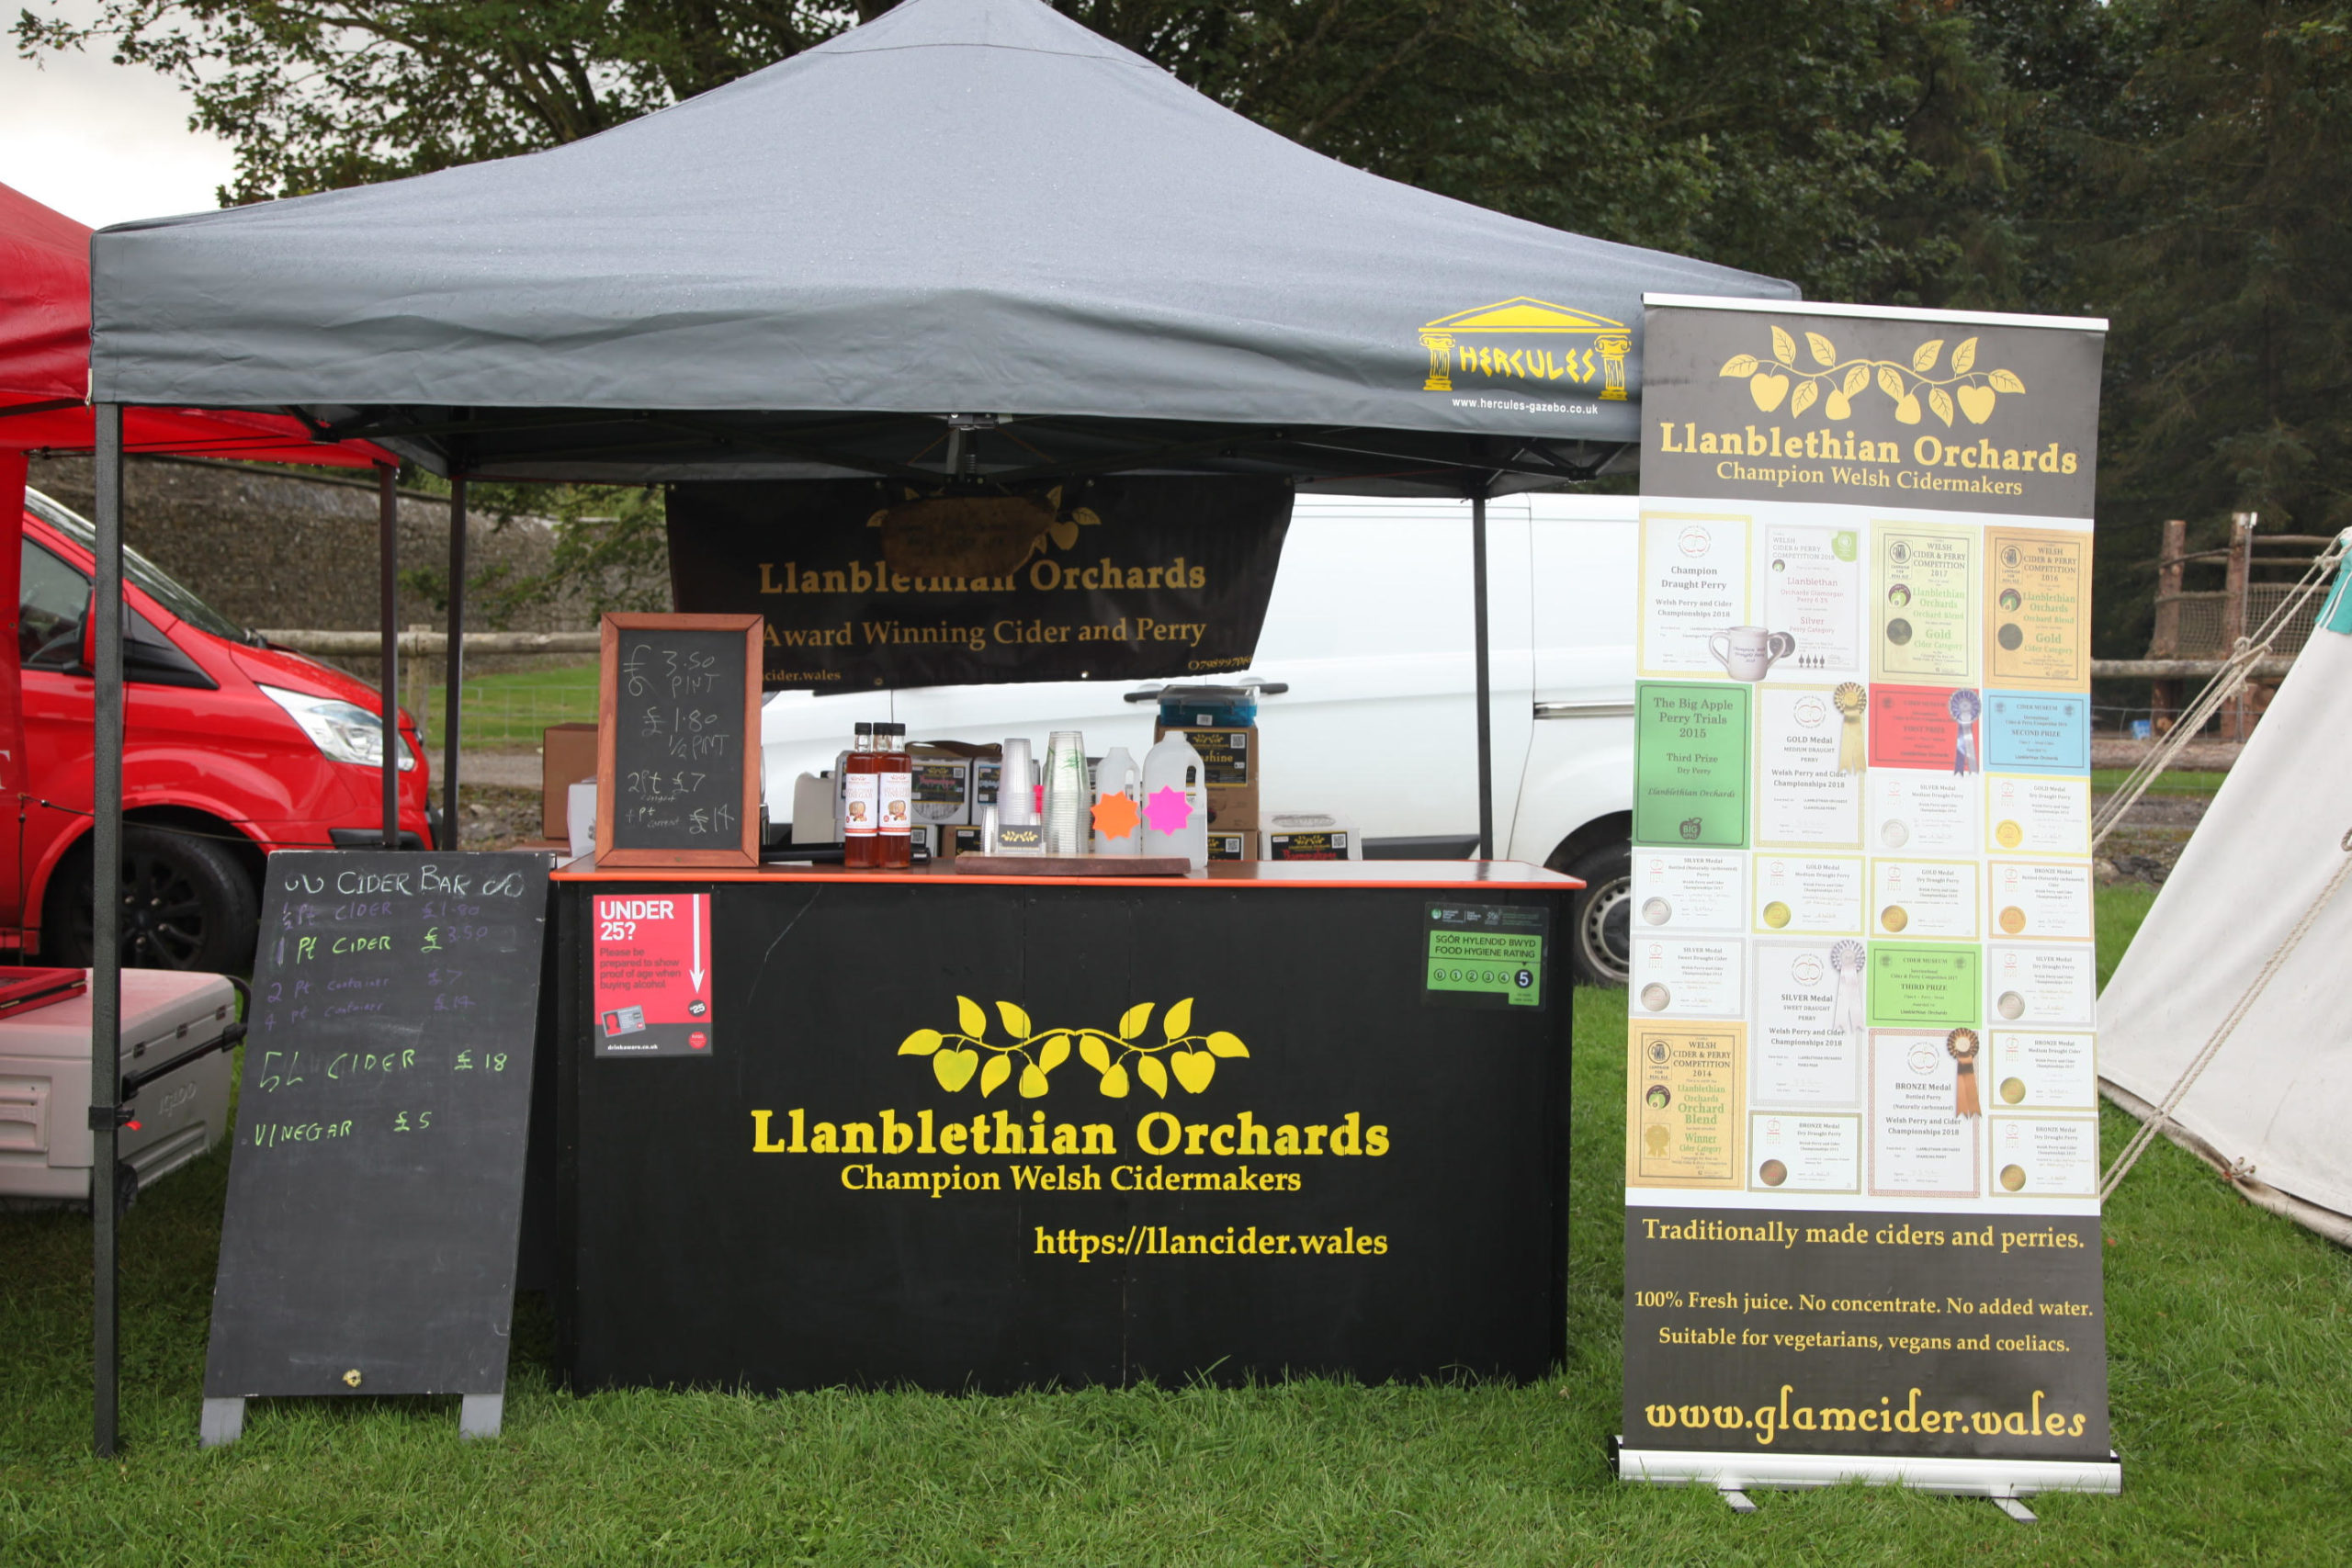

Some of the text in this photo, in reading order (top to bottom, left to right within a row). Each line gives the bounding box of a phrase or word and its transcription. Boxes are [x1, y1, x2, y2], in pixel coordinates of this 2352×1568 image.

[1459, 345, 1597, 383] HERCULES
[1452, 398, 1599, 414] www.hercules-gazebo.co.uk
[1659, 422, 2078, 474] Llanblethian Orchards
[1716, 461, 2023, 495] Champion Welsh Cidermakers
[1670, 566, 1718, 576] Champion
[1914, 560, 1965, 570] COMPETITION
[2024, 565, 2076, 574] COMPETITION
[1030, 558, 1206, 591] Orchards
[1661, 580, 1727, 591] Draught Perry
[1679, 600, 1698, 608] Perry
[763, 617, 1206, 651] Award Winning Cider and Perry
[1926, 629, 1951, 640] Gold
[2036, 633, 2062, 644] Gold
[672, 674, 720, 698] PINT
[1654, 697, 1734, 711] The Big Apple
[1659, 712, 1727, 725] Perry Trials
[1679, 728, 1707, 739] 2015
[692, 734, 729, 761] PINT
[1667, 752, 1718, 763] Third Prize
[335, 901, 392, 920] CIDER
[600, 900, 674, 920] UNDER
[600, 921, 637, 941] 25?
[332, 935, 391, 954] CIDER
[1463, 937, 1507, 946] HYLENDID
[1509, 939, 1536, 947] BWYD
[600, 947, 645, 956] Please be
[1435, 945, 1535, 958] FOOD HYGIENE RATING
[600, 958, 641, 969] prepared
[654, 958, 679, 966] show
[600, 969, 681, 980] proof of age when
[600, 980, 631, 991] buying
[1781, 994, 1833, 1002] SILVER Medal
[327, 1049, 416, 1079] CIDER
[1673, 1059, 1731, 1068] COMPETITION
[1895, 1082, 1951, 1091] BRONZE Medal
[1678, 1103, 1724, 1113] Orchard
[1685, 1114, 1717, 1124] Blend
[254, 1120, 353, 1147] VINEGAR
[751, 1108, 1391, 1156] Llanblethian Orchards
[1685, 1133, 1717, 1144] Winner
[841, 1164, 1303, 1198] Champion Welsh Cidermakers
[1642, 1218, 2086, 1254] Traditionally made ciders and perries.
[1034, 1224, 1389, 1263] https://llancider.wales
[1634, 1291, 2094, 1316] 100% Fresh juice. No concentrate. No added water.
[1658, 1327, 2070, 1354] Suitable for vegetarians, vegans and coeliacs.
[1645, 1384, 2086, 1445] www.glamcider.wales
